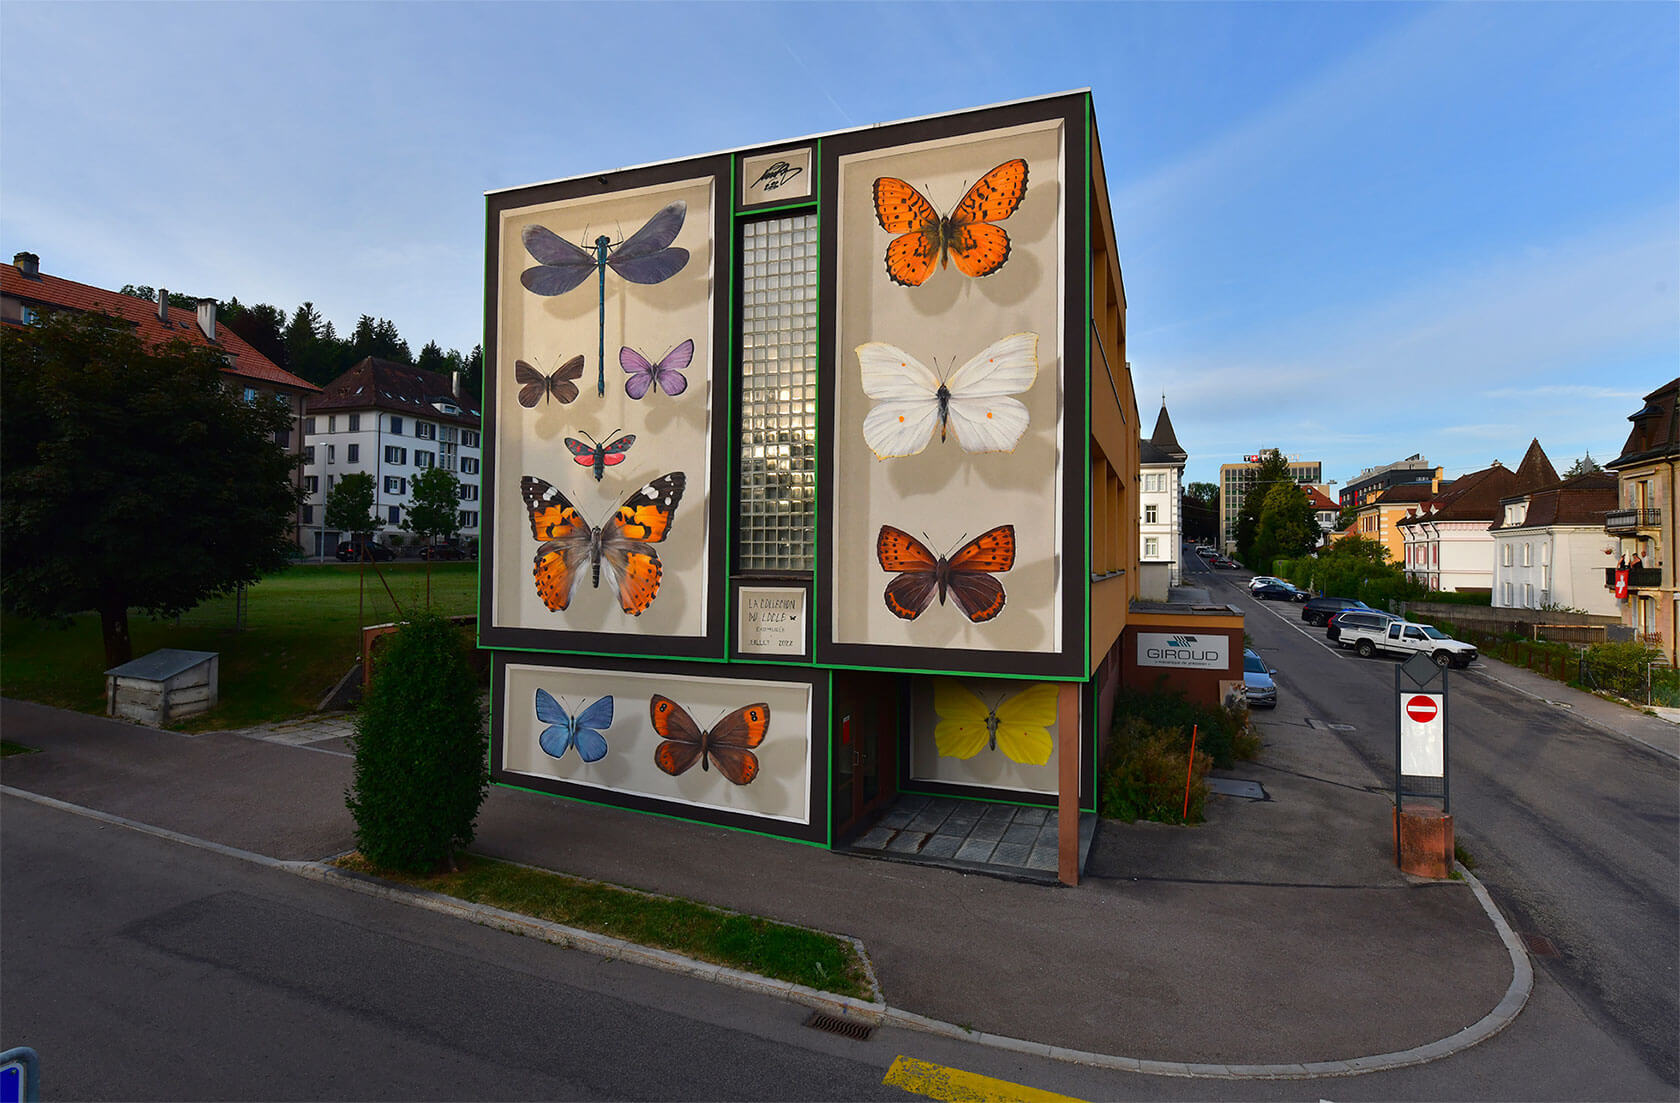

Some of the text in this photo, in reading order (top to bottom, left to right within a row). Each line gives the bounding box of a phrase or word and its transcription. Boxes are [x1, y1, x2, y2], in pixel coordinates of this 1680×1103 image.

[748, 598, 796, 609] LA COLLECTION
[748, 612, 786, 623] DU LOCLE
[1147, 648, 1219, 661] GIROUD
